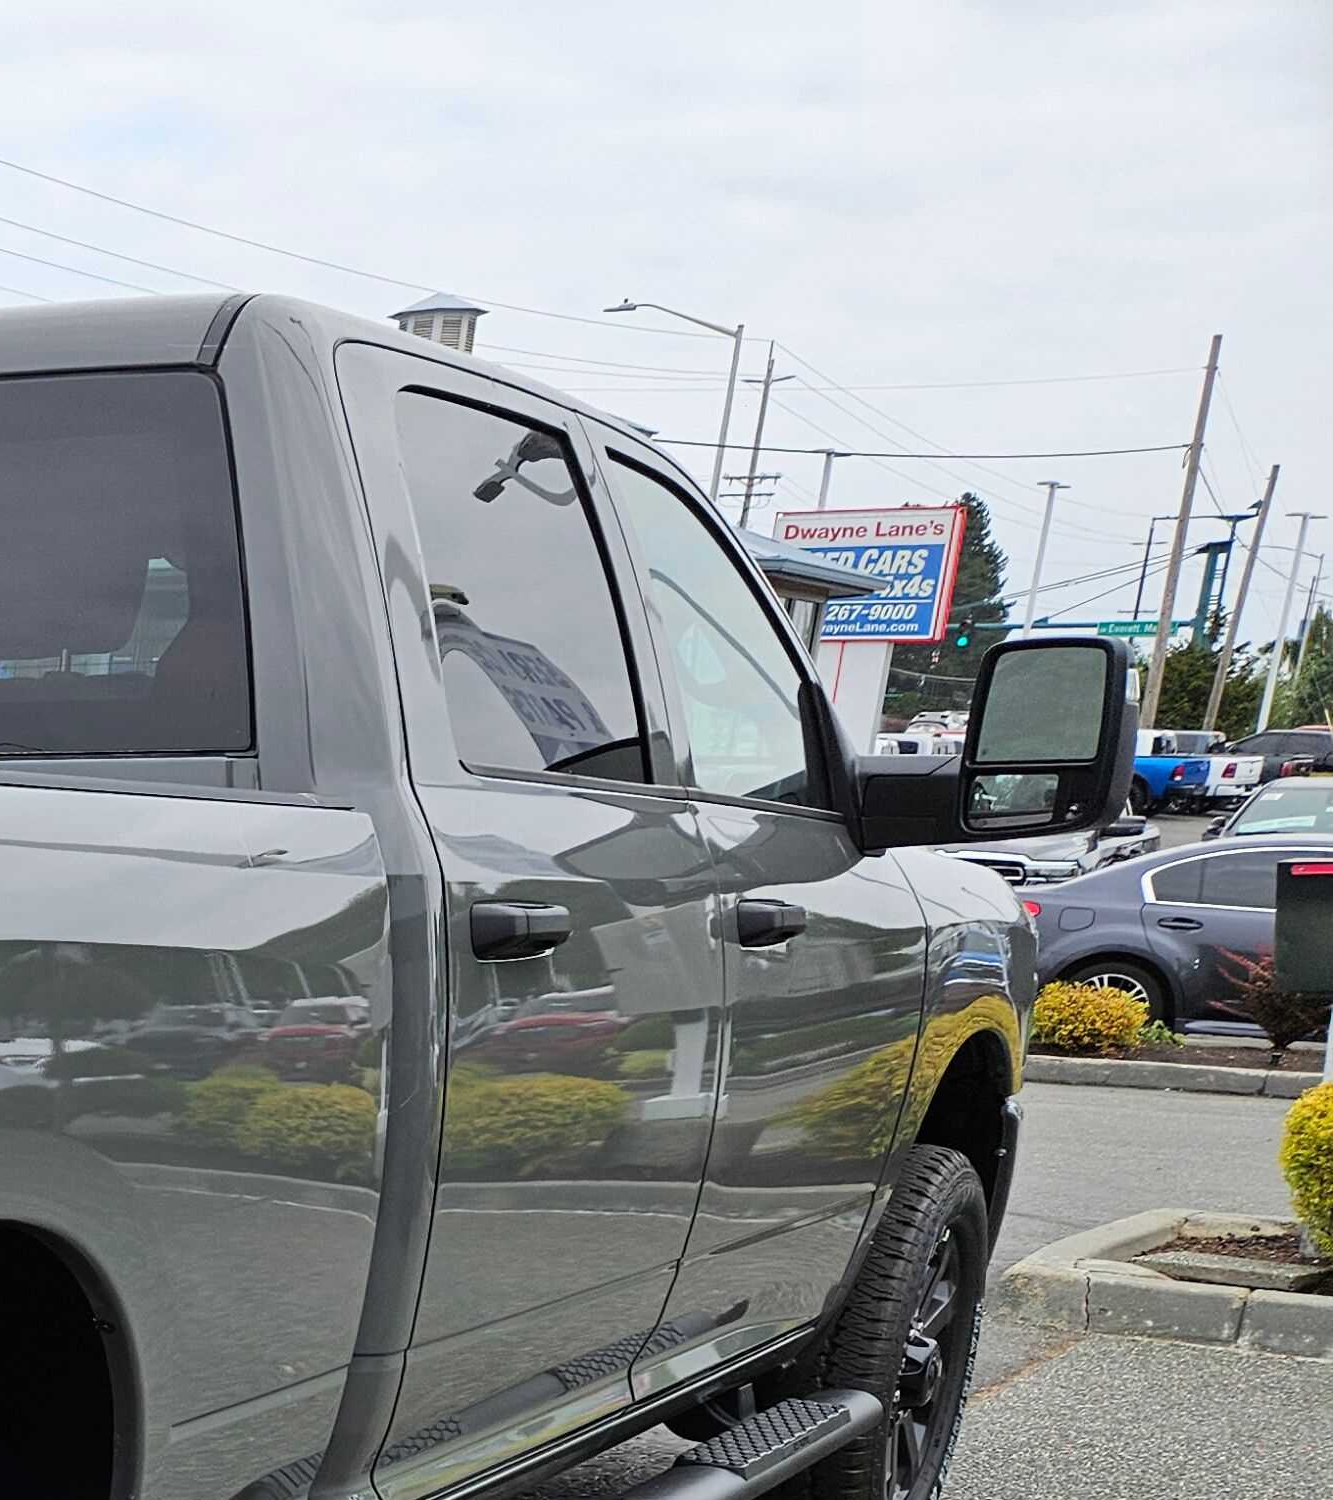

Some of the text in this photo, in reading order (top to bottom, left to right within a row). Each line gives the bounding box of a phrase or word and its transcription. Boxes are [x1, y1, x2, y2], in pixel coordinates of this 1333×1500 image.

[784, 520, 945, 542] Dwayne Lane's
[858, 548, 929, 575] CARS
[824, 604, 918, 621] 267-9000
